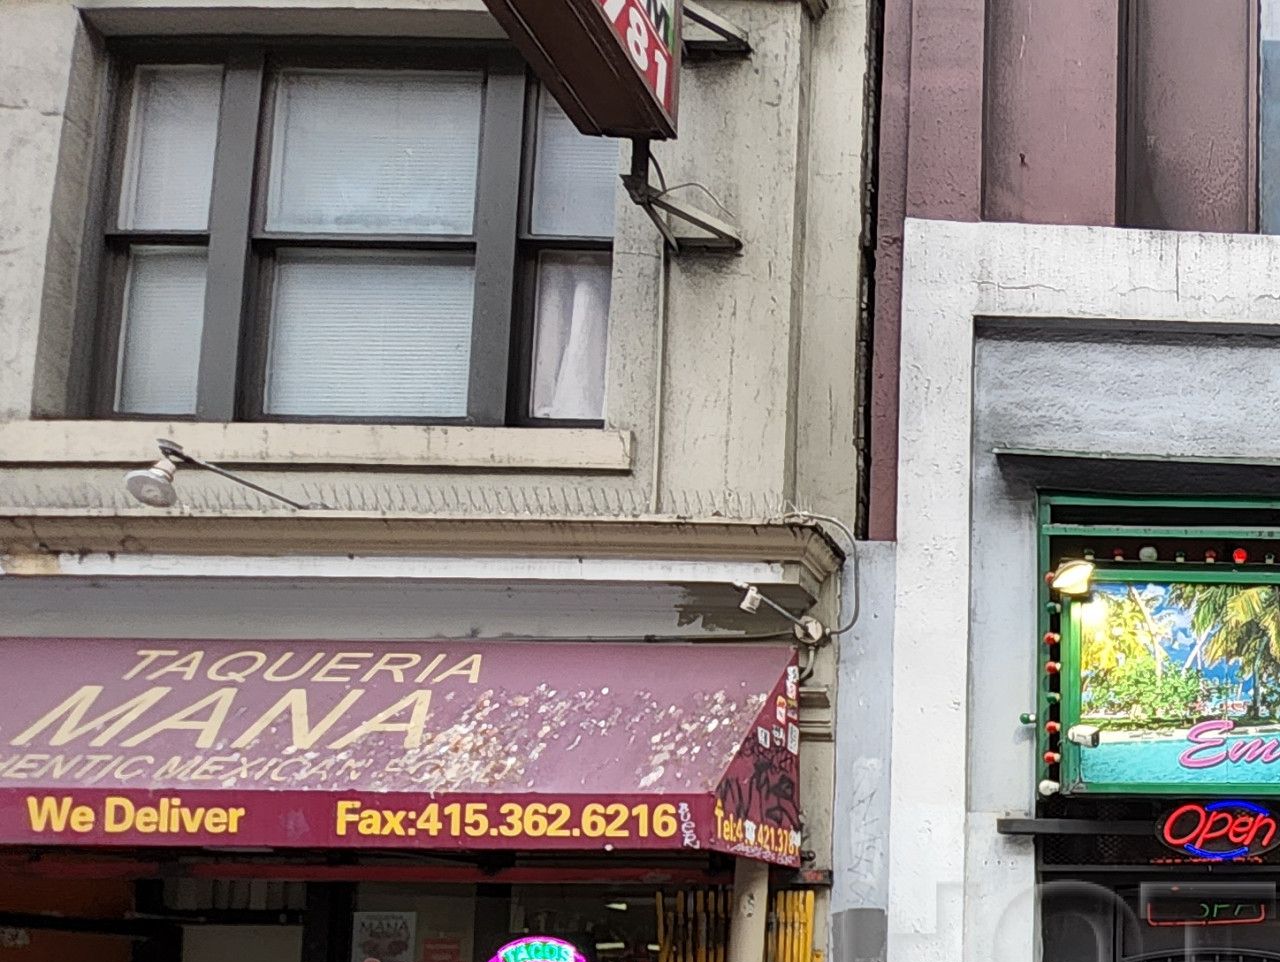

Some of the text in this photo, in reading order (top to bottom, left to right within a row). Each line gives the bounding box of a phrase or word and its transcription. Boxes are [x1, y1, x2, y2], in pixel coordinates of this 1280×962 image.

[122, 650, 482, 685] TAQUERIA
[10, 685, 432, 750] MANA
[26, 796, 246, 834] We Deliver
[336, 800, 678, 838] Fax:415.362.6216
[1162, 804, 1277, 855] Open
